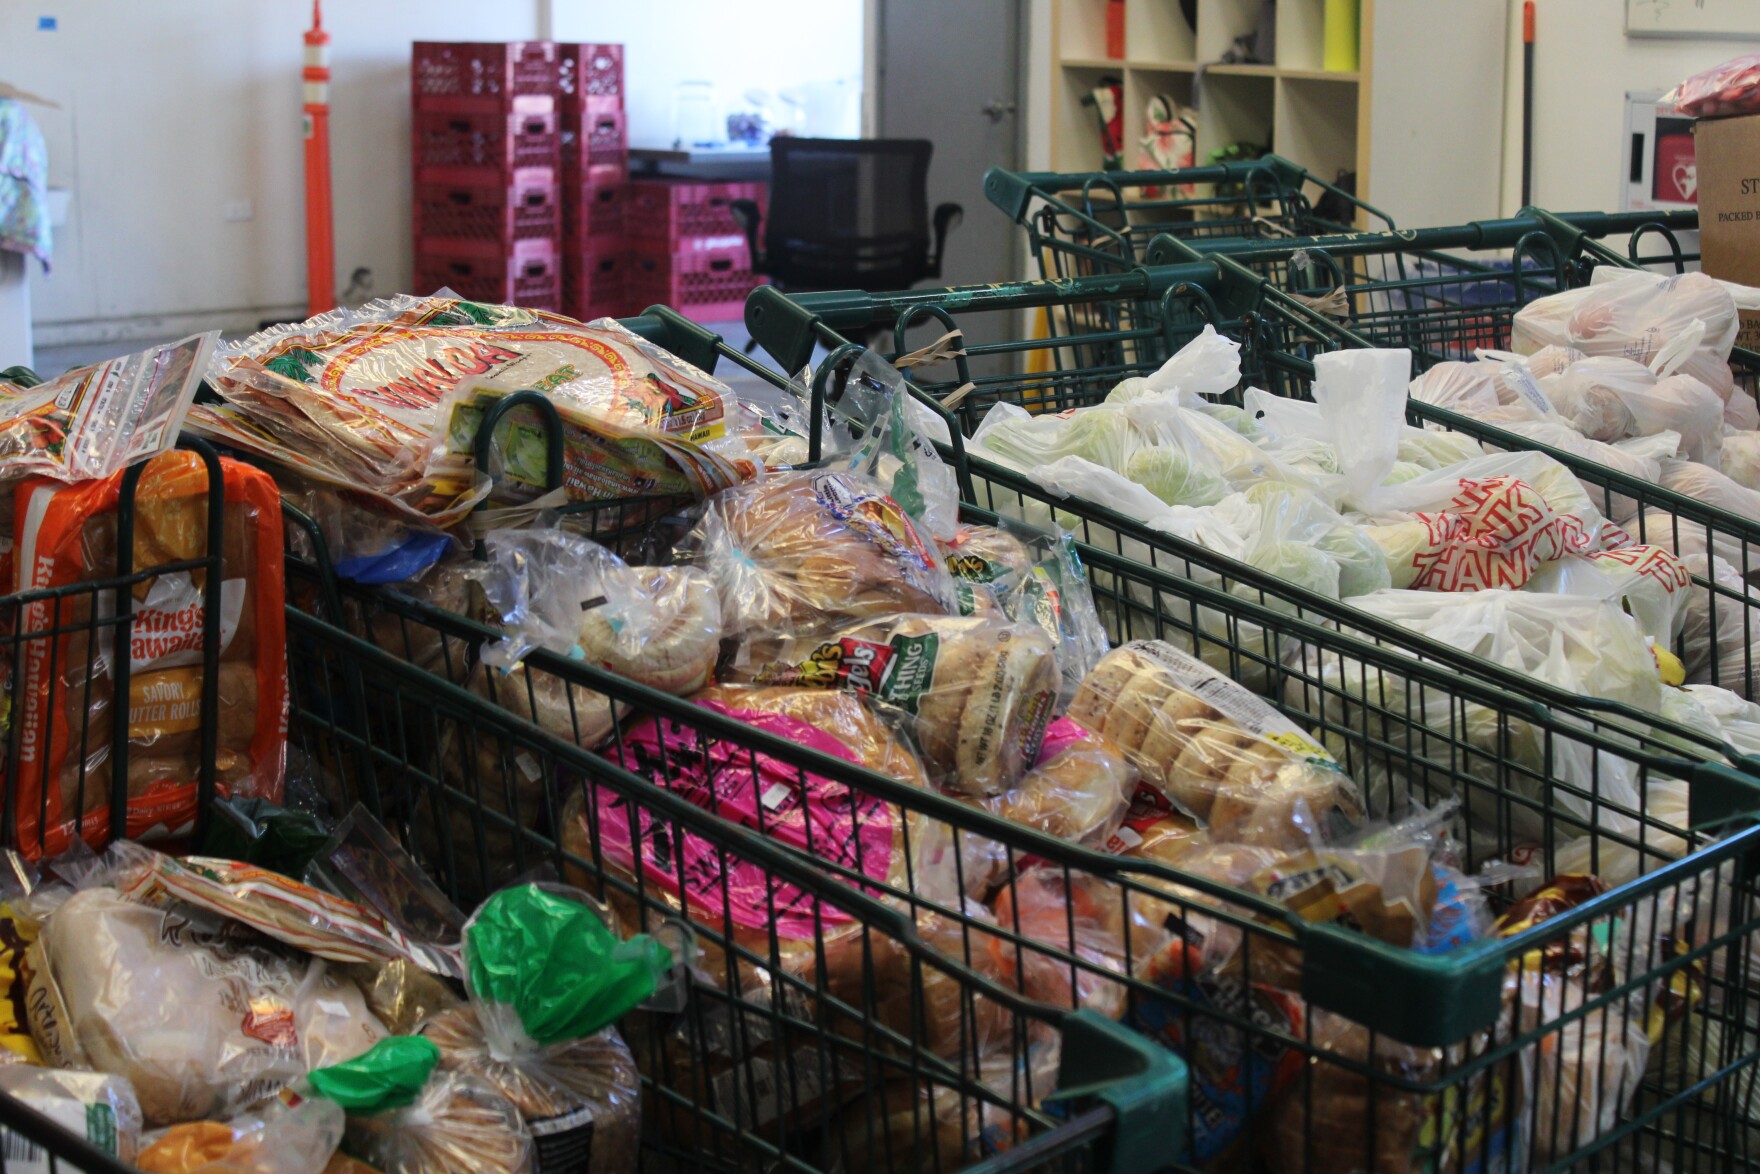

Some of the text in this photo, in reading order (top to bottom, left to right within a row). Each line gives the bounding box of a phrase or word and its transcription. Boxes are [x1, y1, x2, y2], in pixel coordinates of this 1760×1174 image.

[1718, 211, 1753, 222] PACKED
[351, 342, 524, 410] SINALOA
[690, 429, 710, 441] HAWAII
[565, 476, 601, 498] Hawaii
[133, 602, 205, 633] King's
[20, 556, 55, 762] Kig's Hawaiian
[911, 658, 929, 692] SEEDS
[143, 681, 185, 703] SAVORY
[129, 700, 201, 724] UTTER ROLLS
